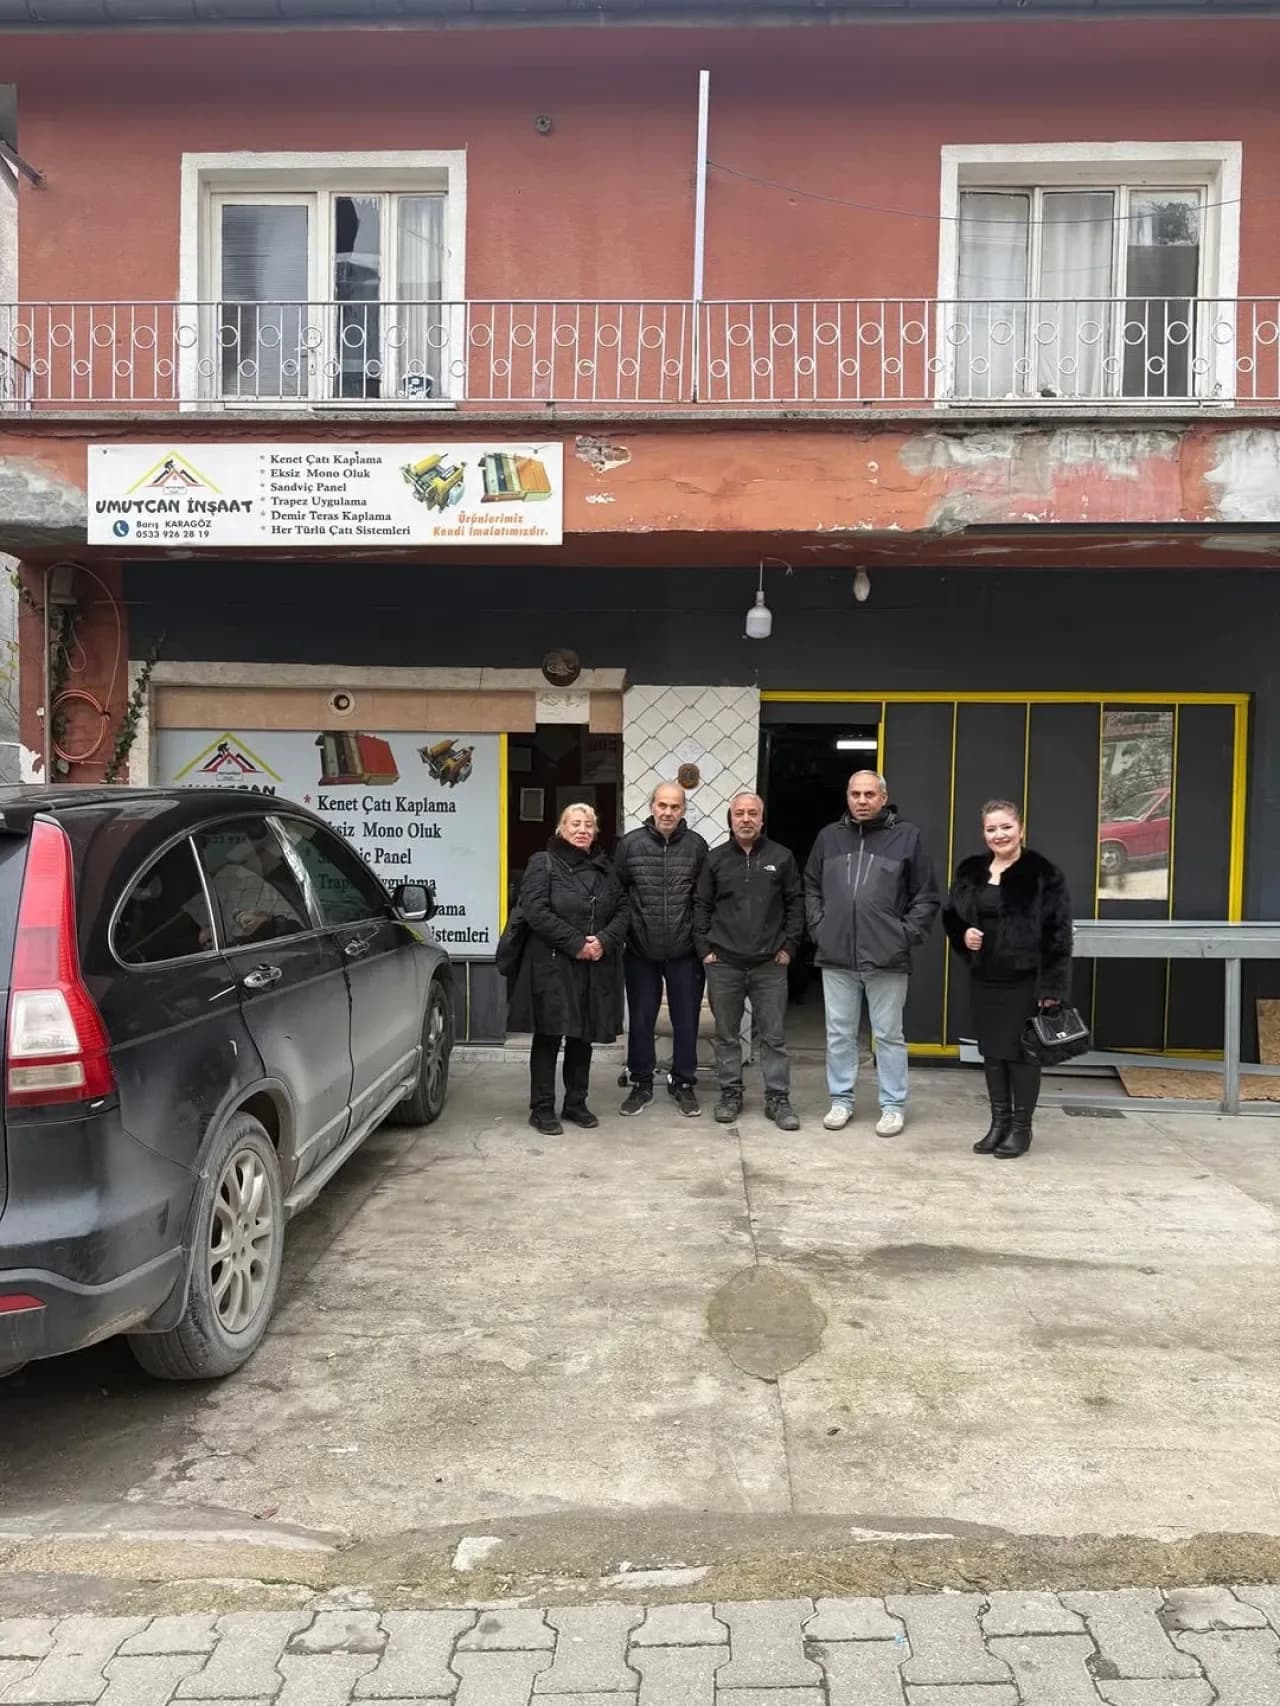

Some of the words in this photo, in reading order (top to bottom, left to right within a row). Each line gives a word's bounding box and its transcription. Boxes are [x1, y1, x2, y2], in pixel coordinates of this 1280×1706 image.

[270, 454, 302, 464] Kenet
[306, 454, 330, 466] Çatı
[333, 455, 383, 466] Kaplama
[270, 469, 301, 478] Eksiz
[307, 468, 340, 478] Mono
[343, 468, 371, 478] Oluk
[270, 482, 313, 493] Sandviç
[316, 482, 347, 492] Panel
[95, 499, 180, 514] UMUTCAN
[187, 497, 253, 516] İNŞAAT
[271, 496, 308, 507] Trapez
[312, 496, 367, 508] Uygulama
[271, 511, 306, 520] Demir
[309, 511, 339, 521] Teras
[342, 511, 391, 522] Kaplama
[165, 519, 212, 528] KARAGÖZ
[136, 530, 159, 539] 0533
[163, 530, 180, 539] 926
[183, 530, 195, 539] 28
[198, 530, 209, 539] 19
[271, 525, 292, 534] Her
[294, 525, 326, 535] Türlü
[329, 525, 352, 536] Çatı
[355, 525, 411, 535] Sistemleri
[433, 526, 465, 536] Kendi
[317, 795, 358, 812] Kenet
[362, 795, 391, 814] Çatı
[395, 796, 457, 816] Kaplama
[362, 821, 403, 838] Mono
[407, 822, 442, 838] Oluk
[374, 848, 412, 865] Panel
[431, 926, 489, 943] istemleri
